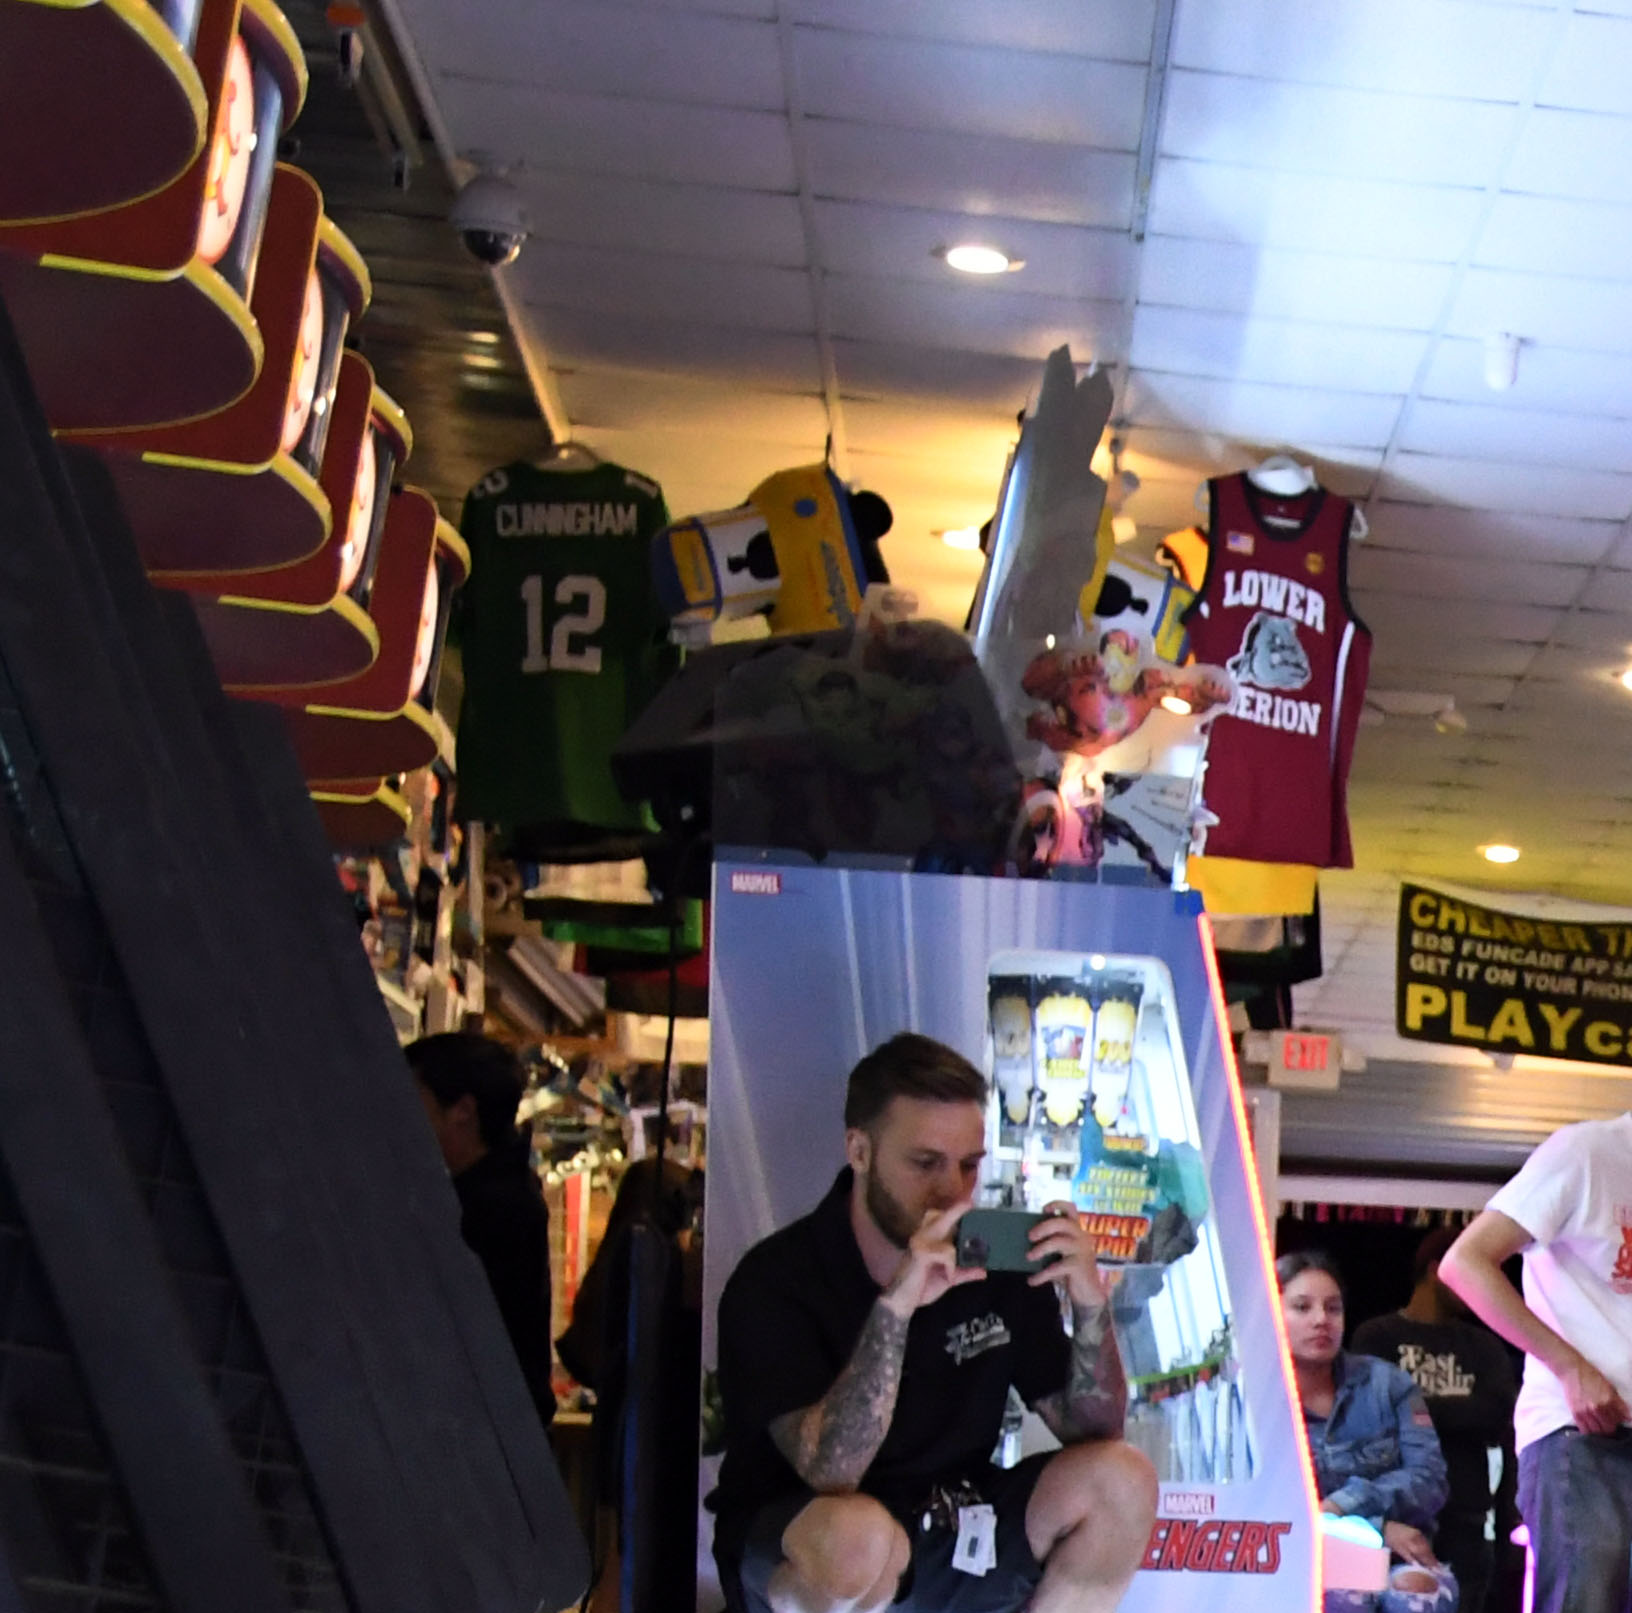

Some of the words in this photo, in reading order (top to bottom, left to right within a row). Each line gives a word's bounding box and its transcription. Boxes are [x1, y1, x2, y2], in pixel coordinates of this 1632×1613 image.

[495, 502, 638, 538] CUNNINGHAM
[1223, 570, 1325, 633] LOWER
[520, 574, 607, 673] 12
[731, 873, 780, 894] MARVEL
[1409, 893, 1592, 951] CHEAPER
[1456, 960, 1479, 981] IT
[1484, 965, 1517, 987] ON
[1282, 1034, 1328, 1071] EXIT
[1165, 1493, 1214, 1515] MARVEL
[1140, 1518, 1293, 1575] ENGERS
